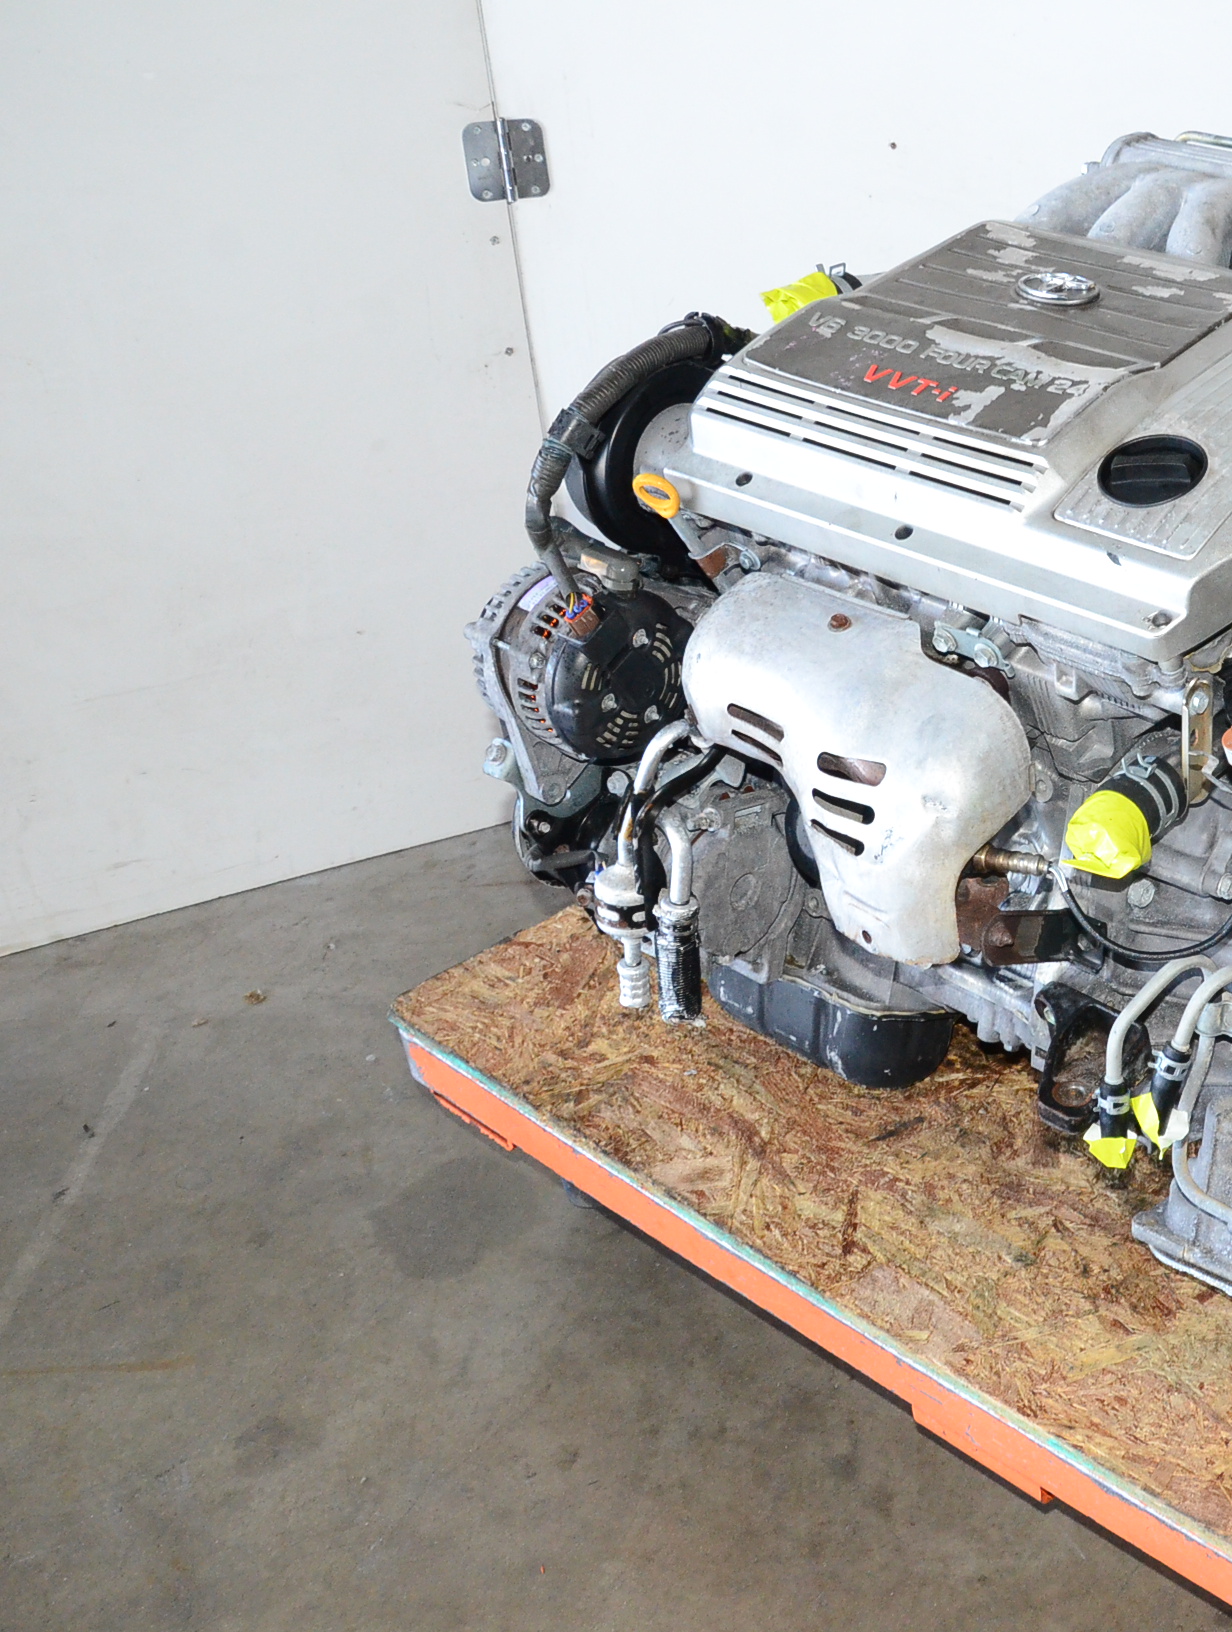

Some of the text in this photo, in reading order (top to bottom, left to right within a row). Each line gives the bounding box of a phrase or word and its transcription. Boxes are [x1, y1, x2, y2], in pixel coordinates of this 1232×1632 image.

[808, 312, 847, 334] V6
[847, 325, 919, 355] 3000
[920, 344, 991, 374] FOUR
[991, 361, 1048, 389] CAM
[863, 364, 958, 402] VVT-i
